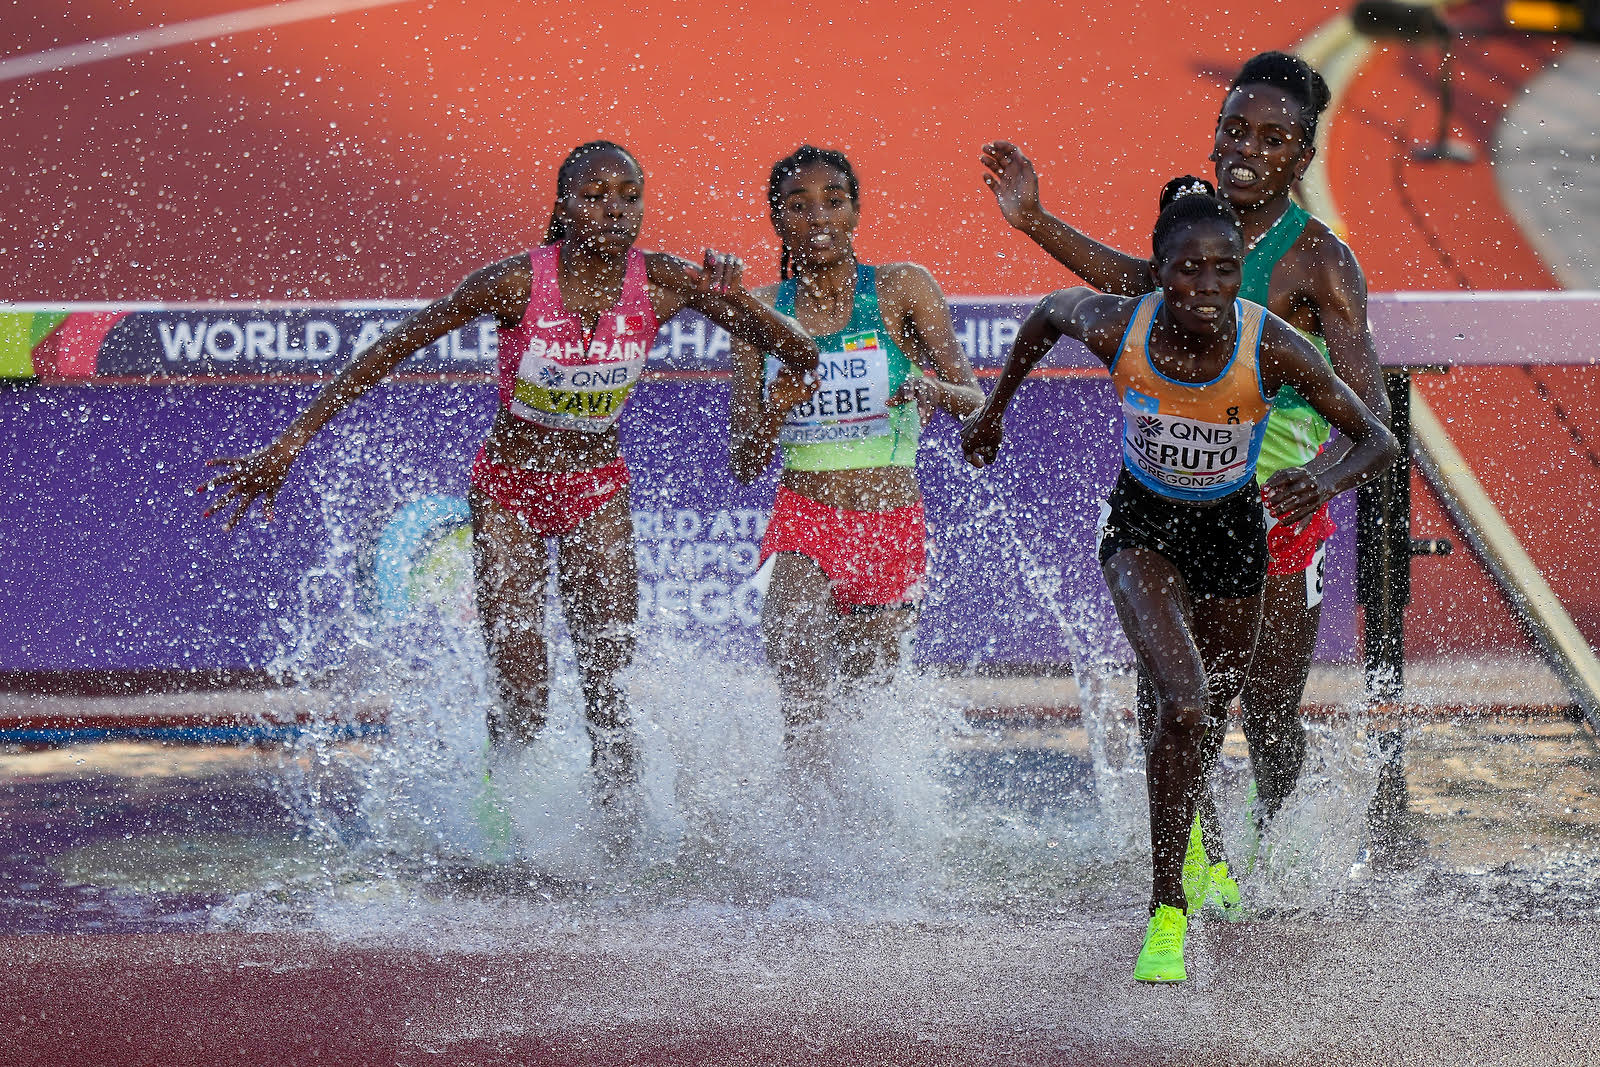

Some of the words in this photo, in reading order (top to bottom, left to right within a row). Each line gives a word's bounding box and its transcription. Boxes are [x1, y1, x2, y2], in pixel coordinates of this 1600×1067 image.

[158, 320, 342, 362] WORLD
[529, 337, 647, 361] BAHRAIN
[571, 367, 628, 388] QNB
[551, 391, 613, 413] YAVI
[1169, 422, 1233, 445] QNB
[1133, 433, 1238, 470] JERUTO
[1138, 458, 1226, 487] OREGON22
